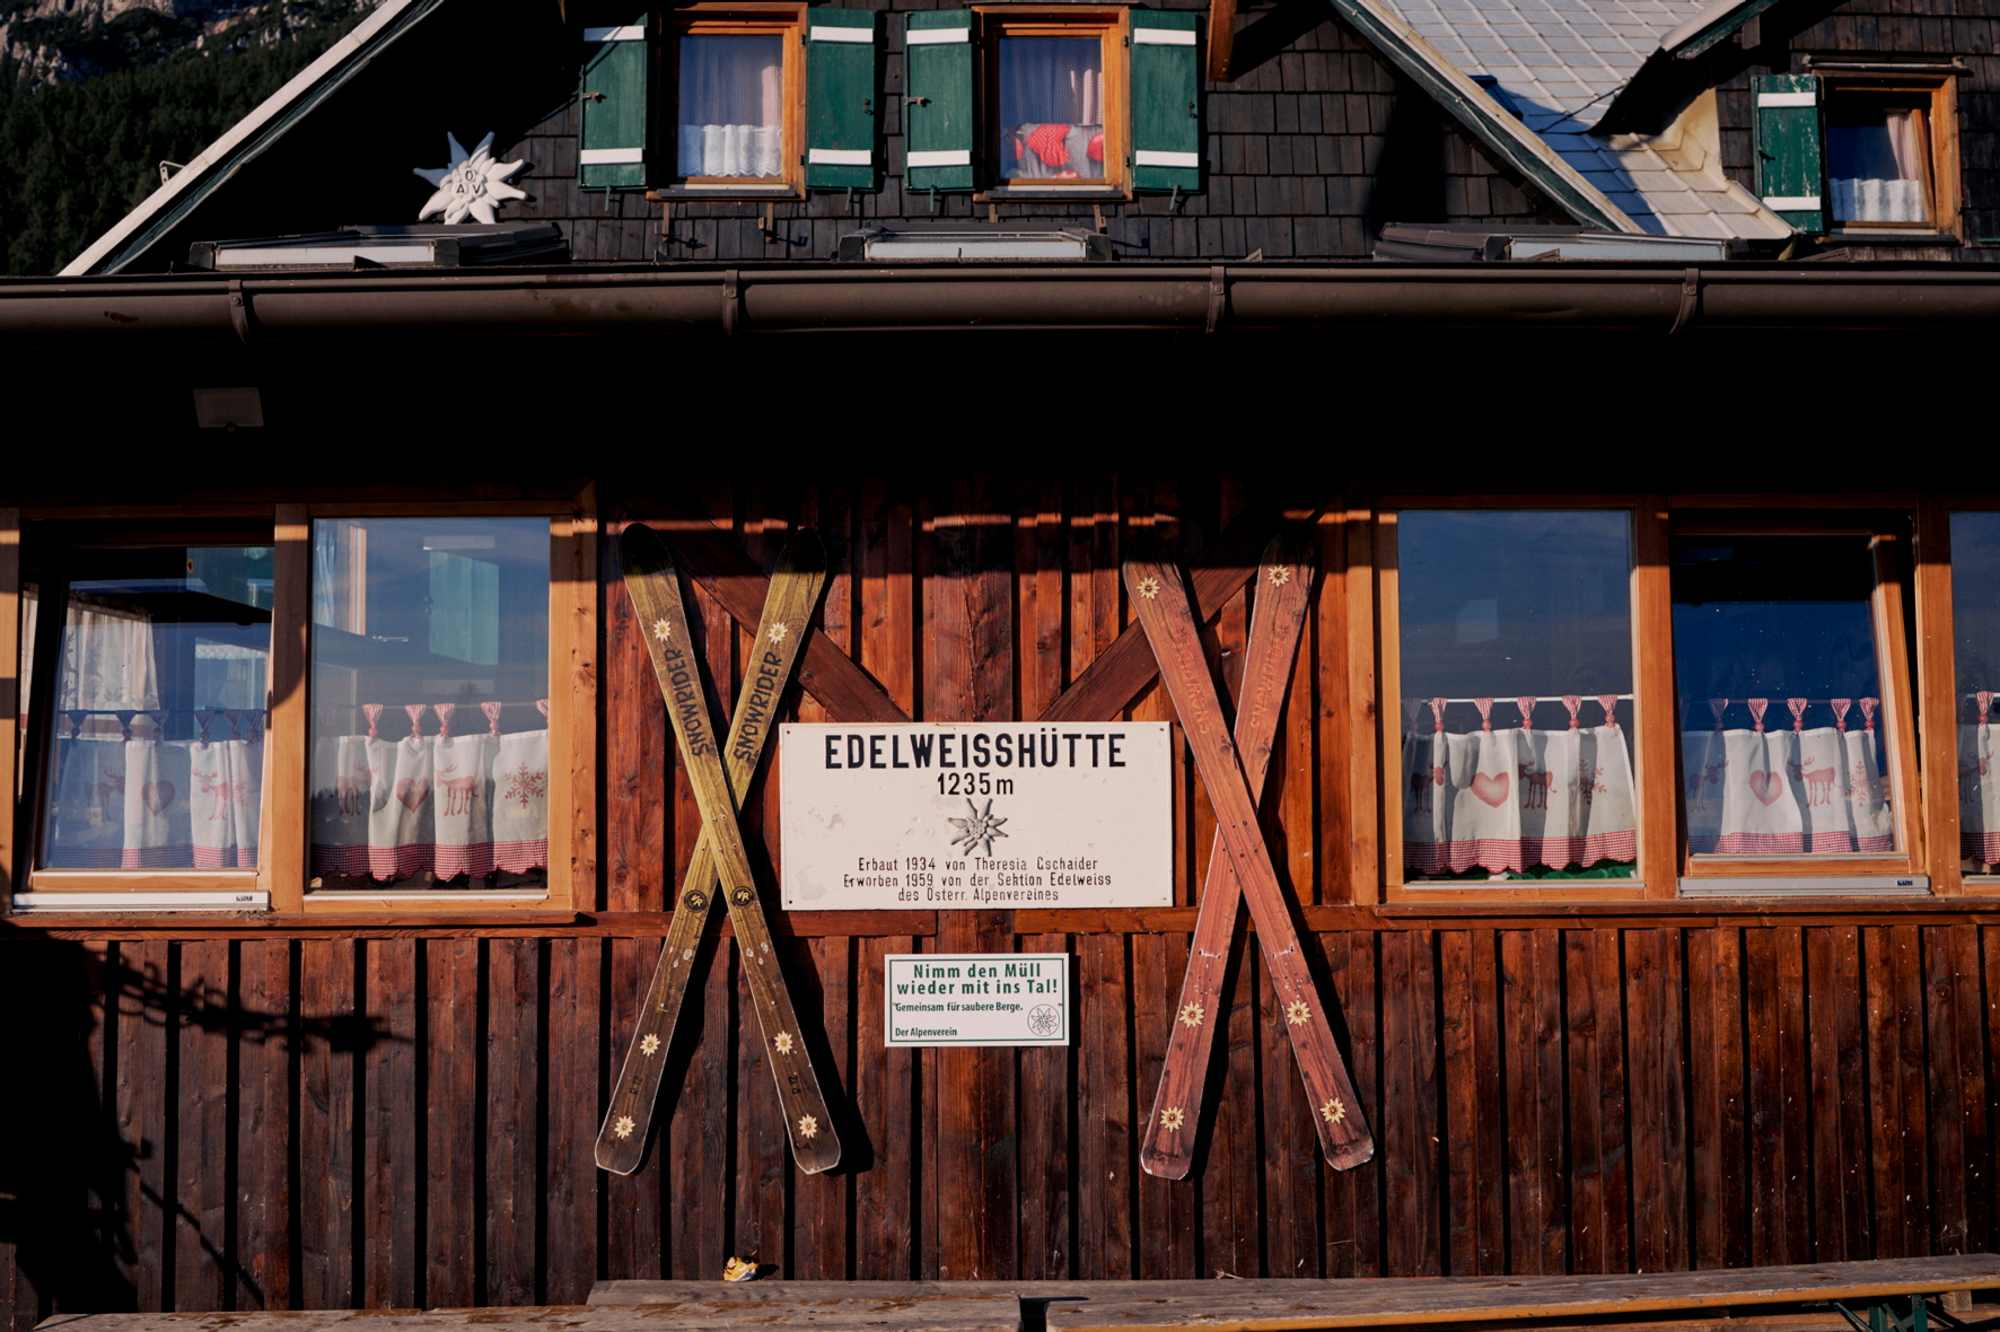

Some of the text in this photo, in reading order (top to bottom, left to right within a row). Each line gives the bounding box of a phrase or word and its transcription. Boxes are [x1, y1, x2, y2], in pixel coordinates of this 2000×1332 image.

[664, 648, 709, 757] SNOWRIDER
[733, 650, 782, 761] SNOWRIDER
[825, 727, 1127, 770] EDELWEISSHÜTTE
[858, 856, 1098, 871] Erbaut 1934 von Theresia Gschaider
[843, 872, 1112, 888] Erworben 1959 von der Sektion Edelweiss
[898, 887, 920, 902] des
[973, 887, 1059, 904] Alpenvereines
[913, 963, 1041, 979] Nimm den Müll
[896, 979, 1058, 995] wieder mit ins Tal!
[895, 1002, 1024, 1014] Gemeinsam für saubere Berge.
[895, 1027, 958, 1038] Der Alpenverein
